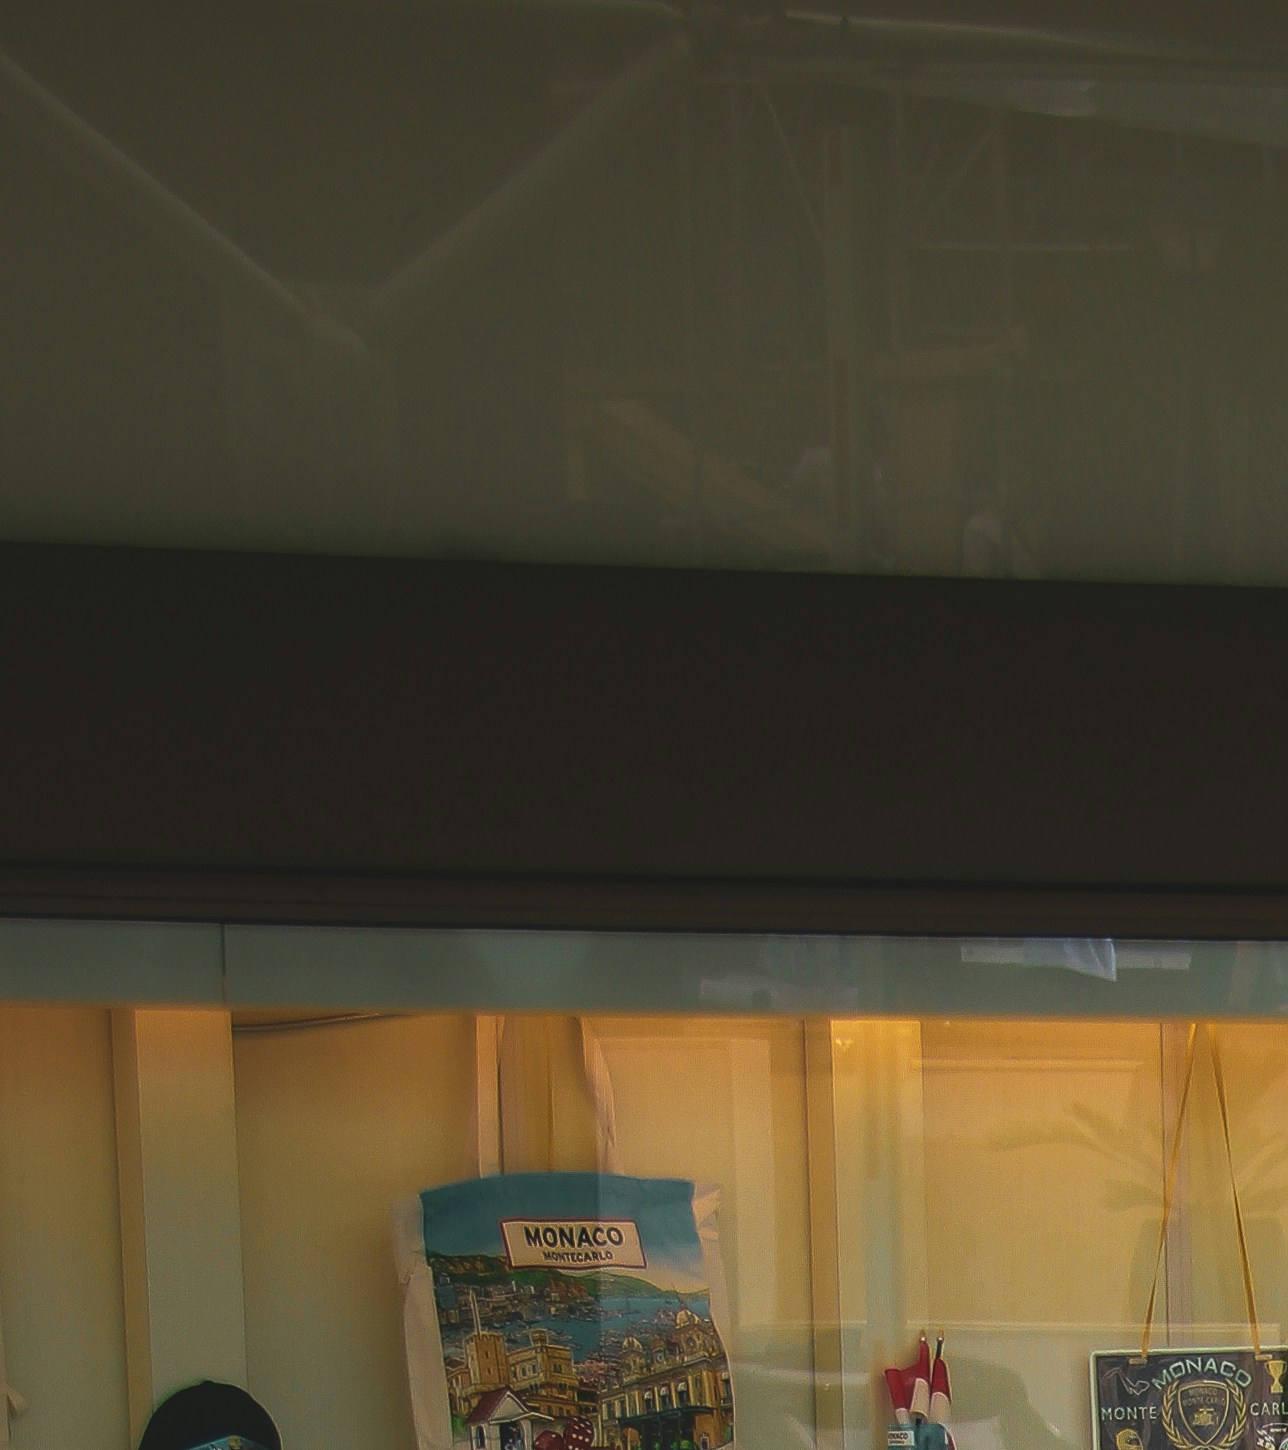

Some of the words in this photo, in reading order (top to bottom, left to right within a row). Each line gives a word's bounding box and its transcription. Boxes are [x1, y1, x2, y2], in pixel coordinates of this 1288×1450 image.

[524, 1226, 624, 1249] MONACO
[543, 1250, 614, 1264] MONTECARLO
[1152, 1357, 1252, 1390] MONACO
[1101, 1406, 1157, 1421] MONTE
